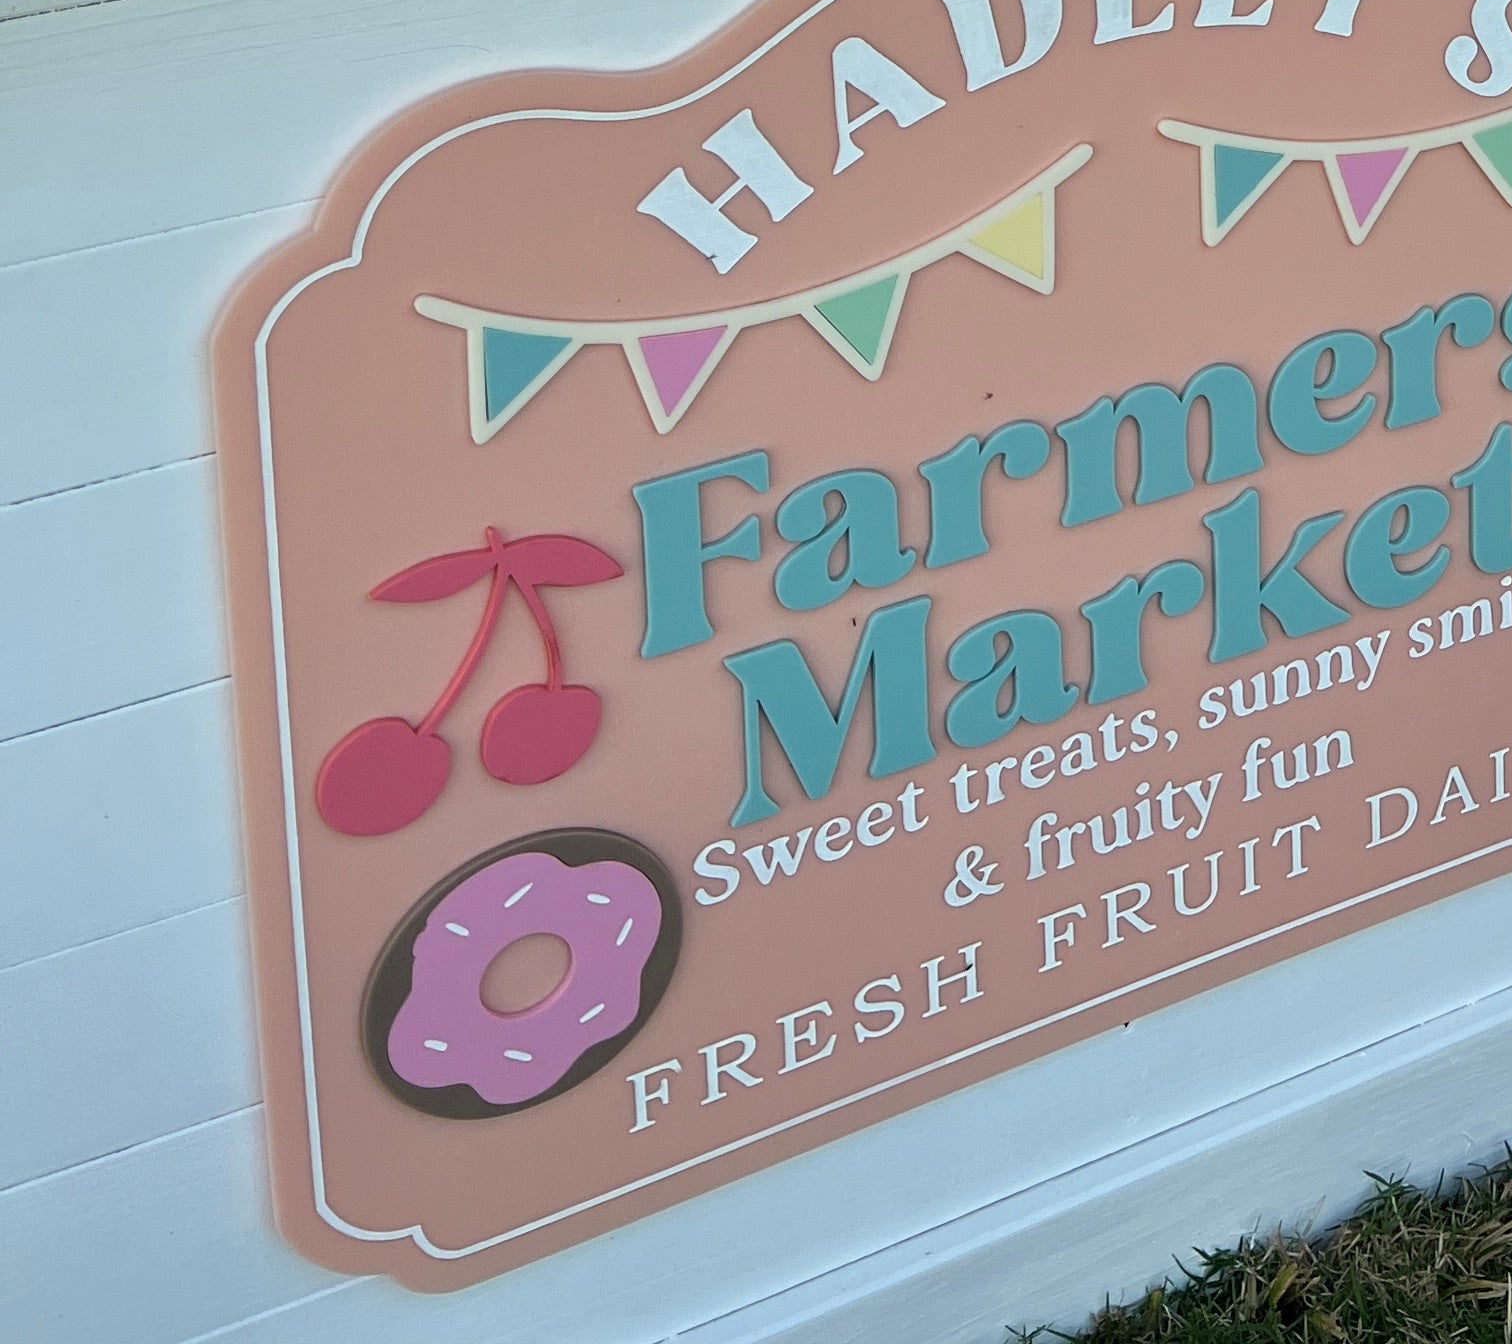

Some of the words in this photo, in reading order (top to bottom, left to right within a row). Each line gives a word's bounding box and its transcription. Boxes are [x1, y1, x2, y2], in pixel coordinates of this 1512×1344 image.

[692, 784, 928, 907] Sweet
[949, 708, 1180, 814] treats,
[1198, 629, 1392, 730] sunny
[942, 846, 1005, 908] &
[1023, 770, 1223, 883] fruity
[1242, 728, 1354, 807] fun
[627, 943, 985, 1134] FRESH
[1037, 816, 1324, 972] FRUIT
